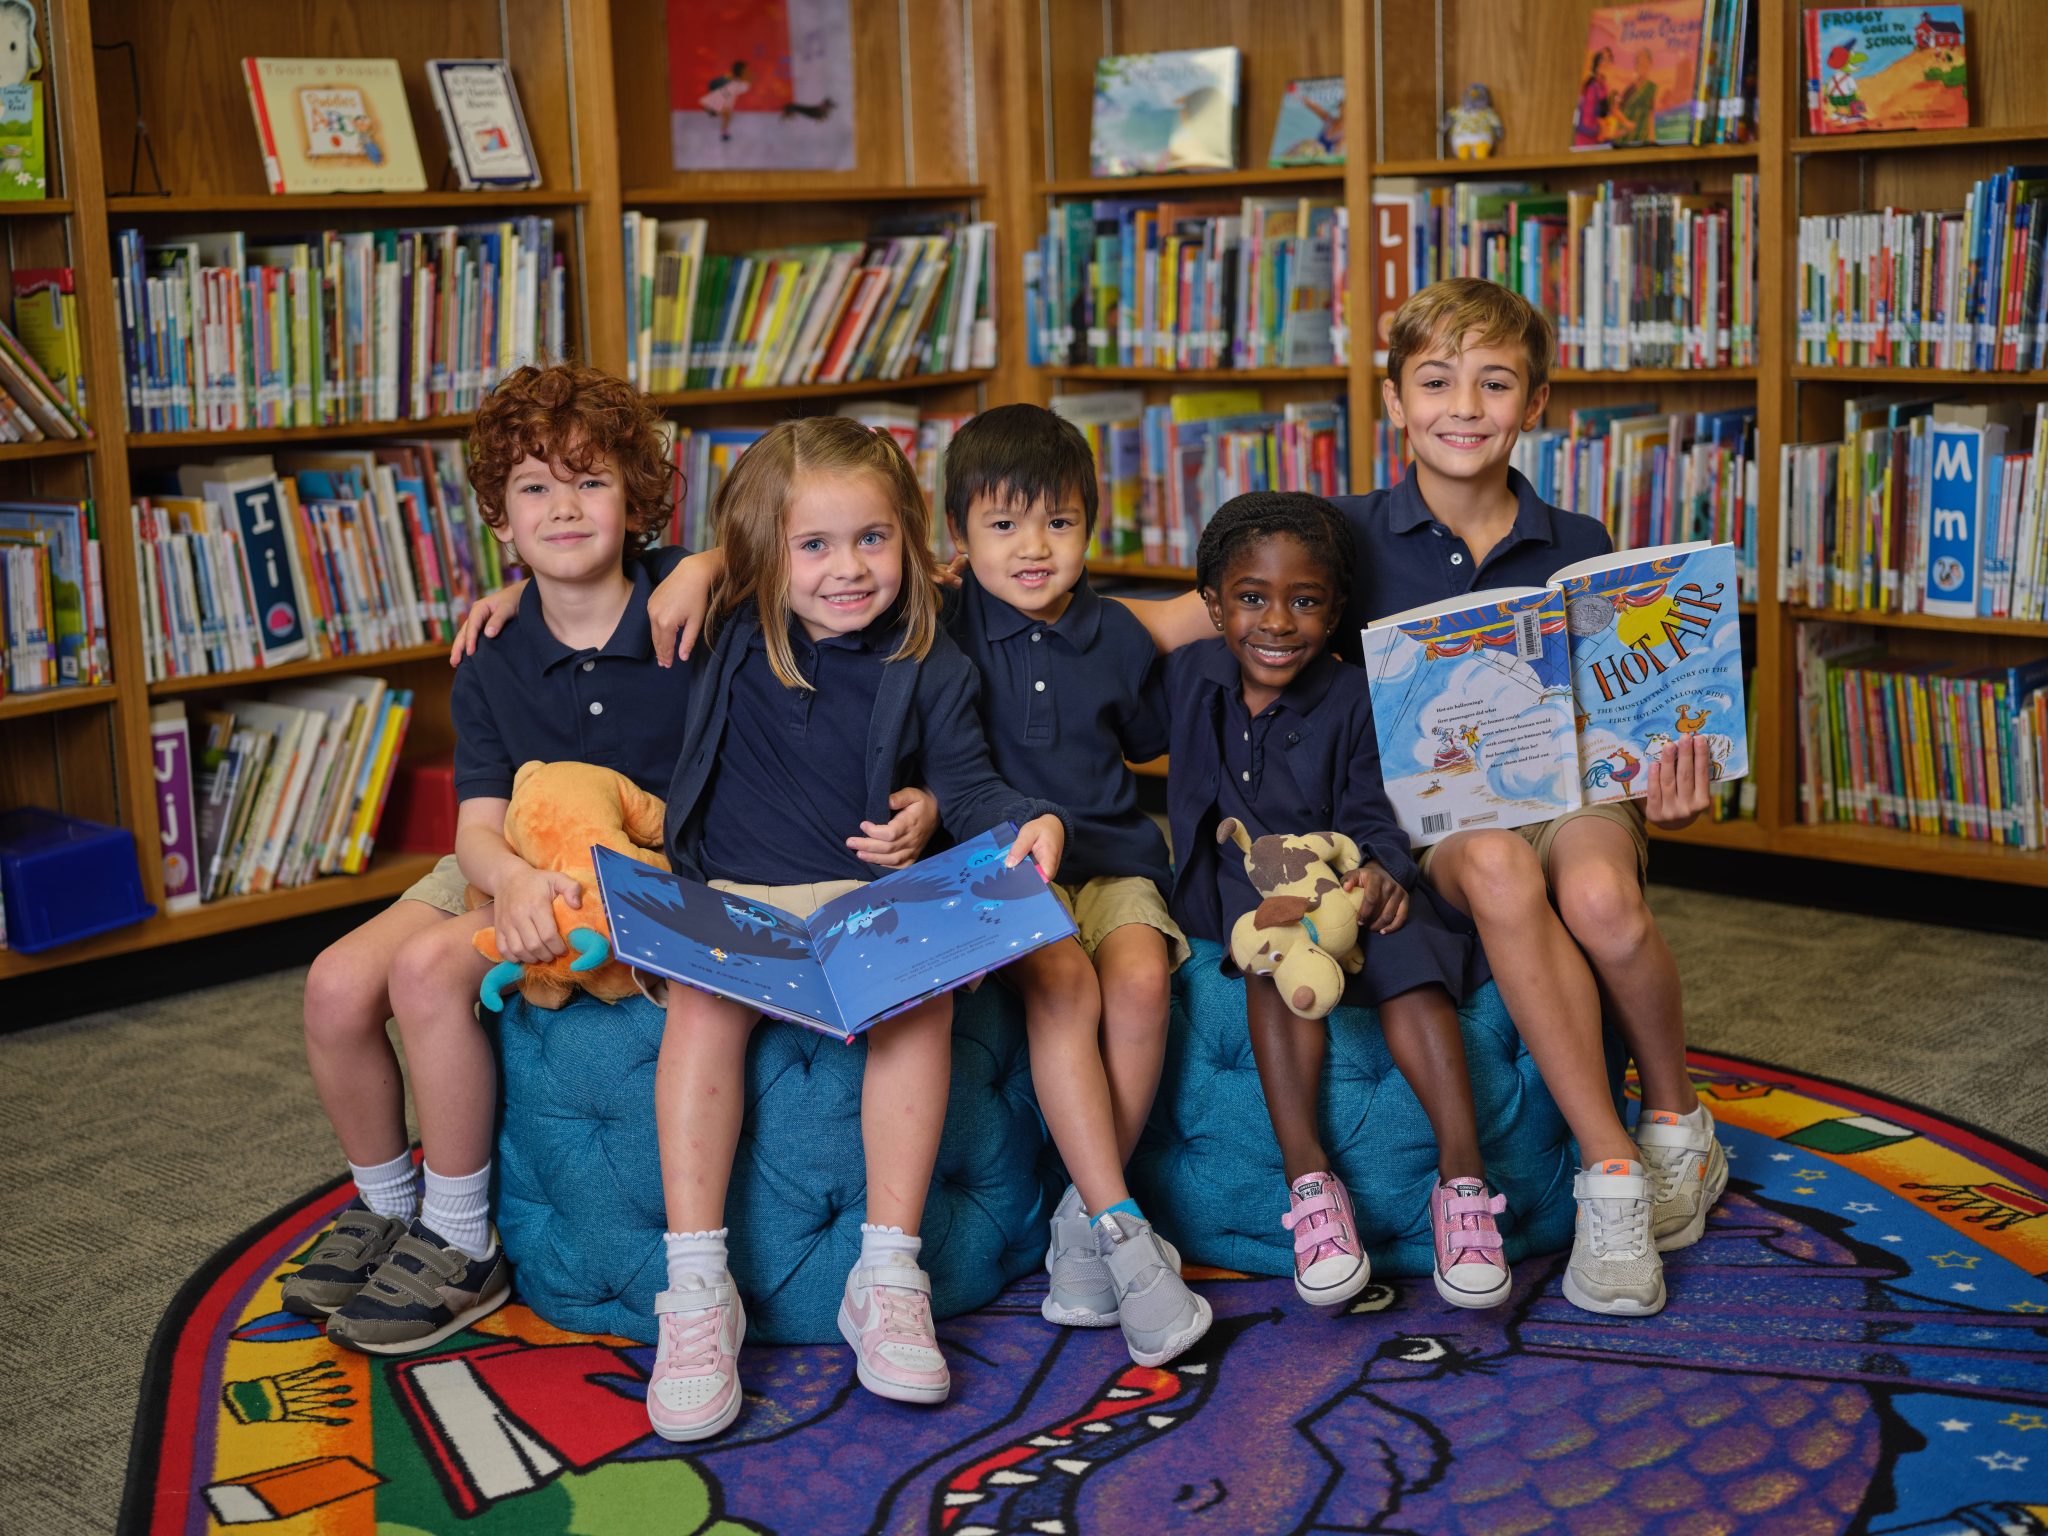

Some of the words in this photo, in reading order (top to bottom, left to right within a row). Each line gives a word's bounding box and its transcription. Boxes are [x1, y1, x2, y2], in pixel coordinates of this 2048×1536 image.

[1822, 10, 1884, 28] FROGGY
[1861, 23, 1889, 34] GOES
[1892, 22, 1905, 32] TO
[1865, 34, 1914, 49] SCHOOL
[1934, 440, 1972, 482] M
[1934, 508, 1967, 541] m
[1589, 633, 1669, 702] HOT
[1660, 583, 1724, 663] AIR
[1597, 707, 1613, 715] THE
[1651, 683, 1670, 700] TRUE
[1671, 670, 1696, 685] STORY
[1609, 715, 1631, 723] FIRST
[1664, 688, 1704, 704] BALLOON
[1706, 690, 1724, 699] RIDE
[1449, 713, 1475, 722] passengers
[154, 739, 178, 782] J
